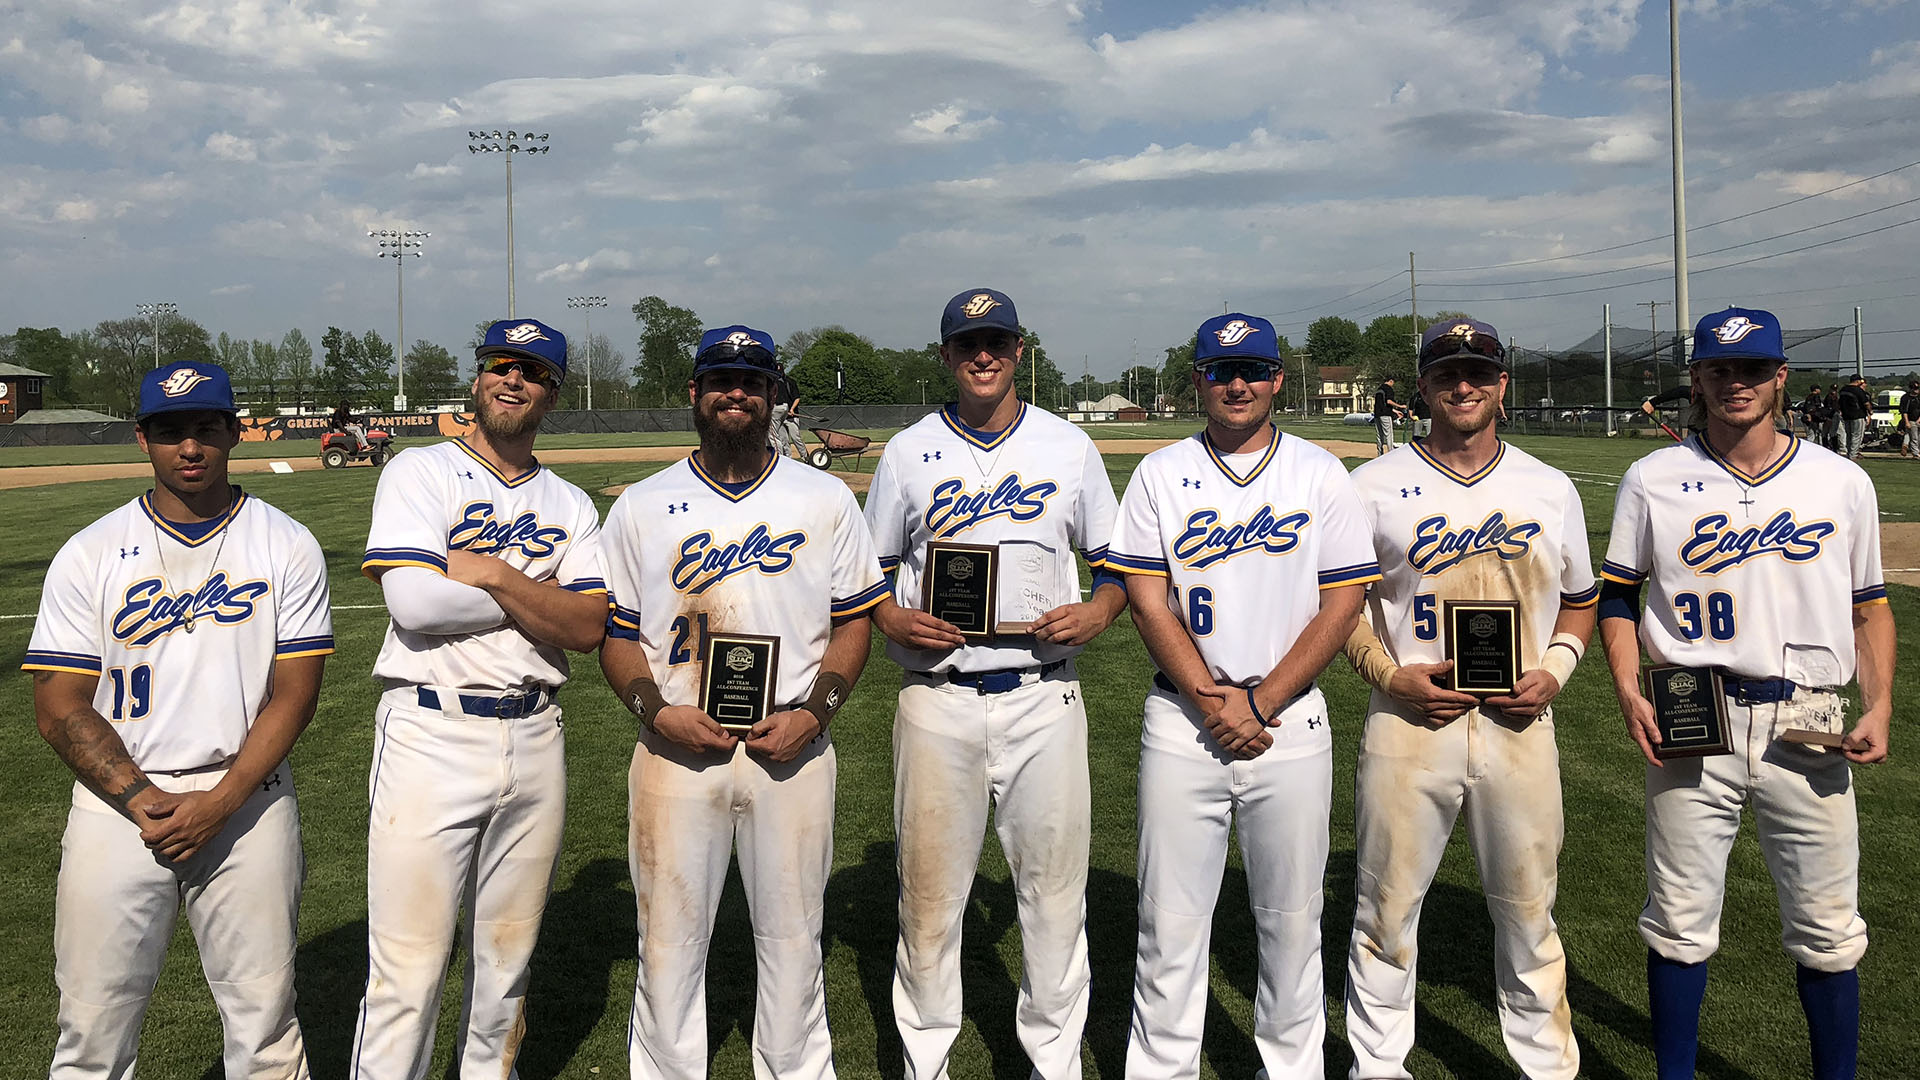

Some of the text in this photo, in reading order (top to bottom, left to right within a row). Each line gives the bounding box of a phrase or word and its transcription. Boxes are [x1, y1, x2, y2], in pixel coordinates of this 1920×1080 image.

[1215, 320, 1257, 347] SU
[1713, 317, 1759, 344] SU
[160, 368, 208, 397] SU
[286, 416, 433, 429] GREEN PANTHERS
[448, 500, 571, 560] Eagles
[923, 471, 1059, 541] Eagles
[669, 522, 808, 596] Eagles
[1171, 503, 1312, 571] Eagles
[1406, 509, 1543, 576] Eagles
[1677, 508, 1838, 576] Eagles
[111, 570, 271, 649] Eagles
[1412, 591, 1439, 643] 5
[1673, 590, 1736, 642] 38
[667, 611, 711, 667] 21
[108, 662, 154, 722] 19
[1670, 680, 1694, 690] SLIAC
